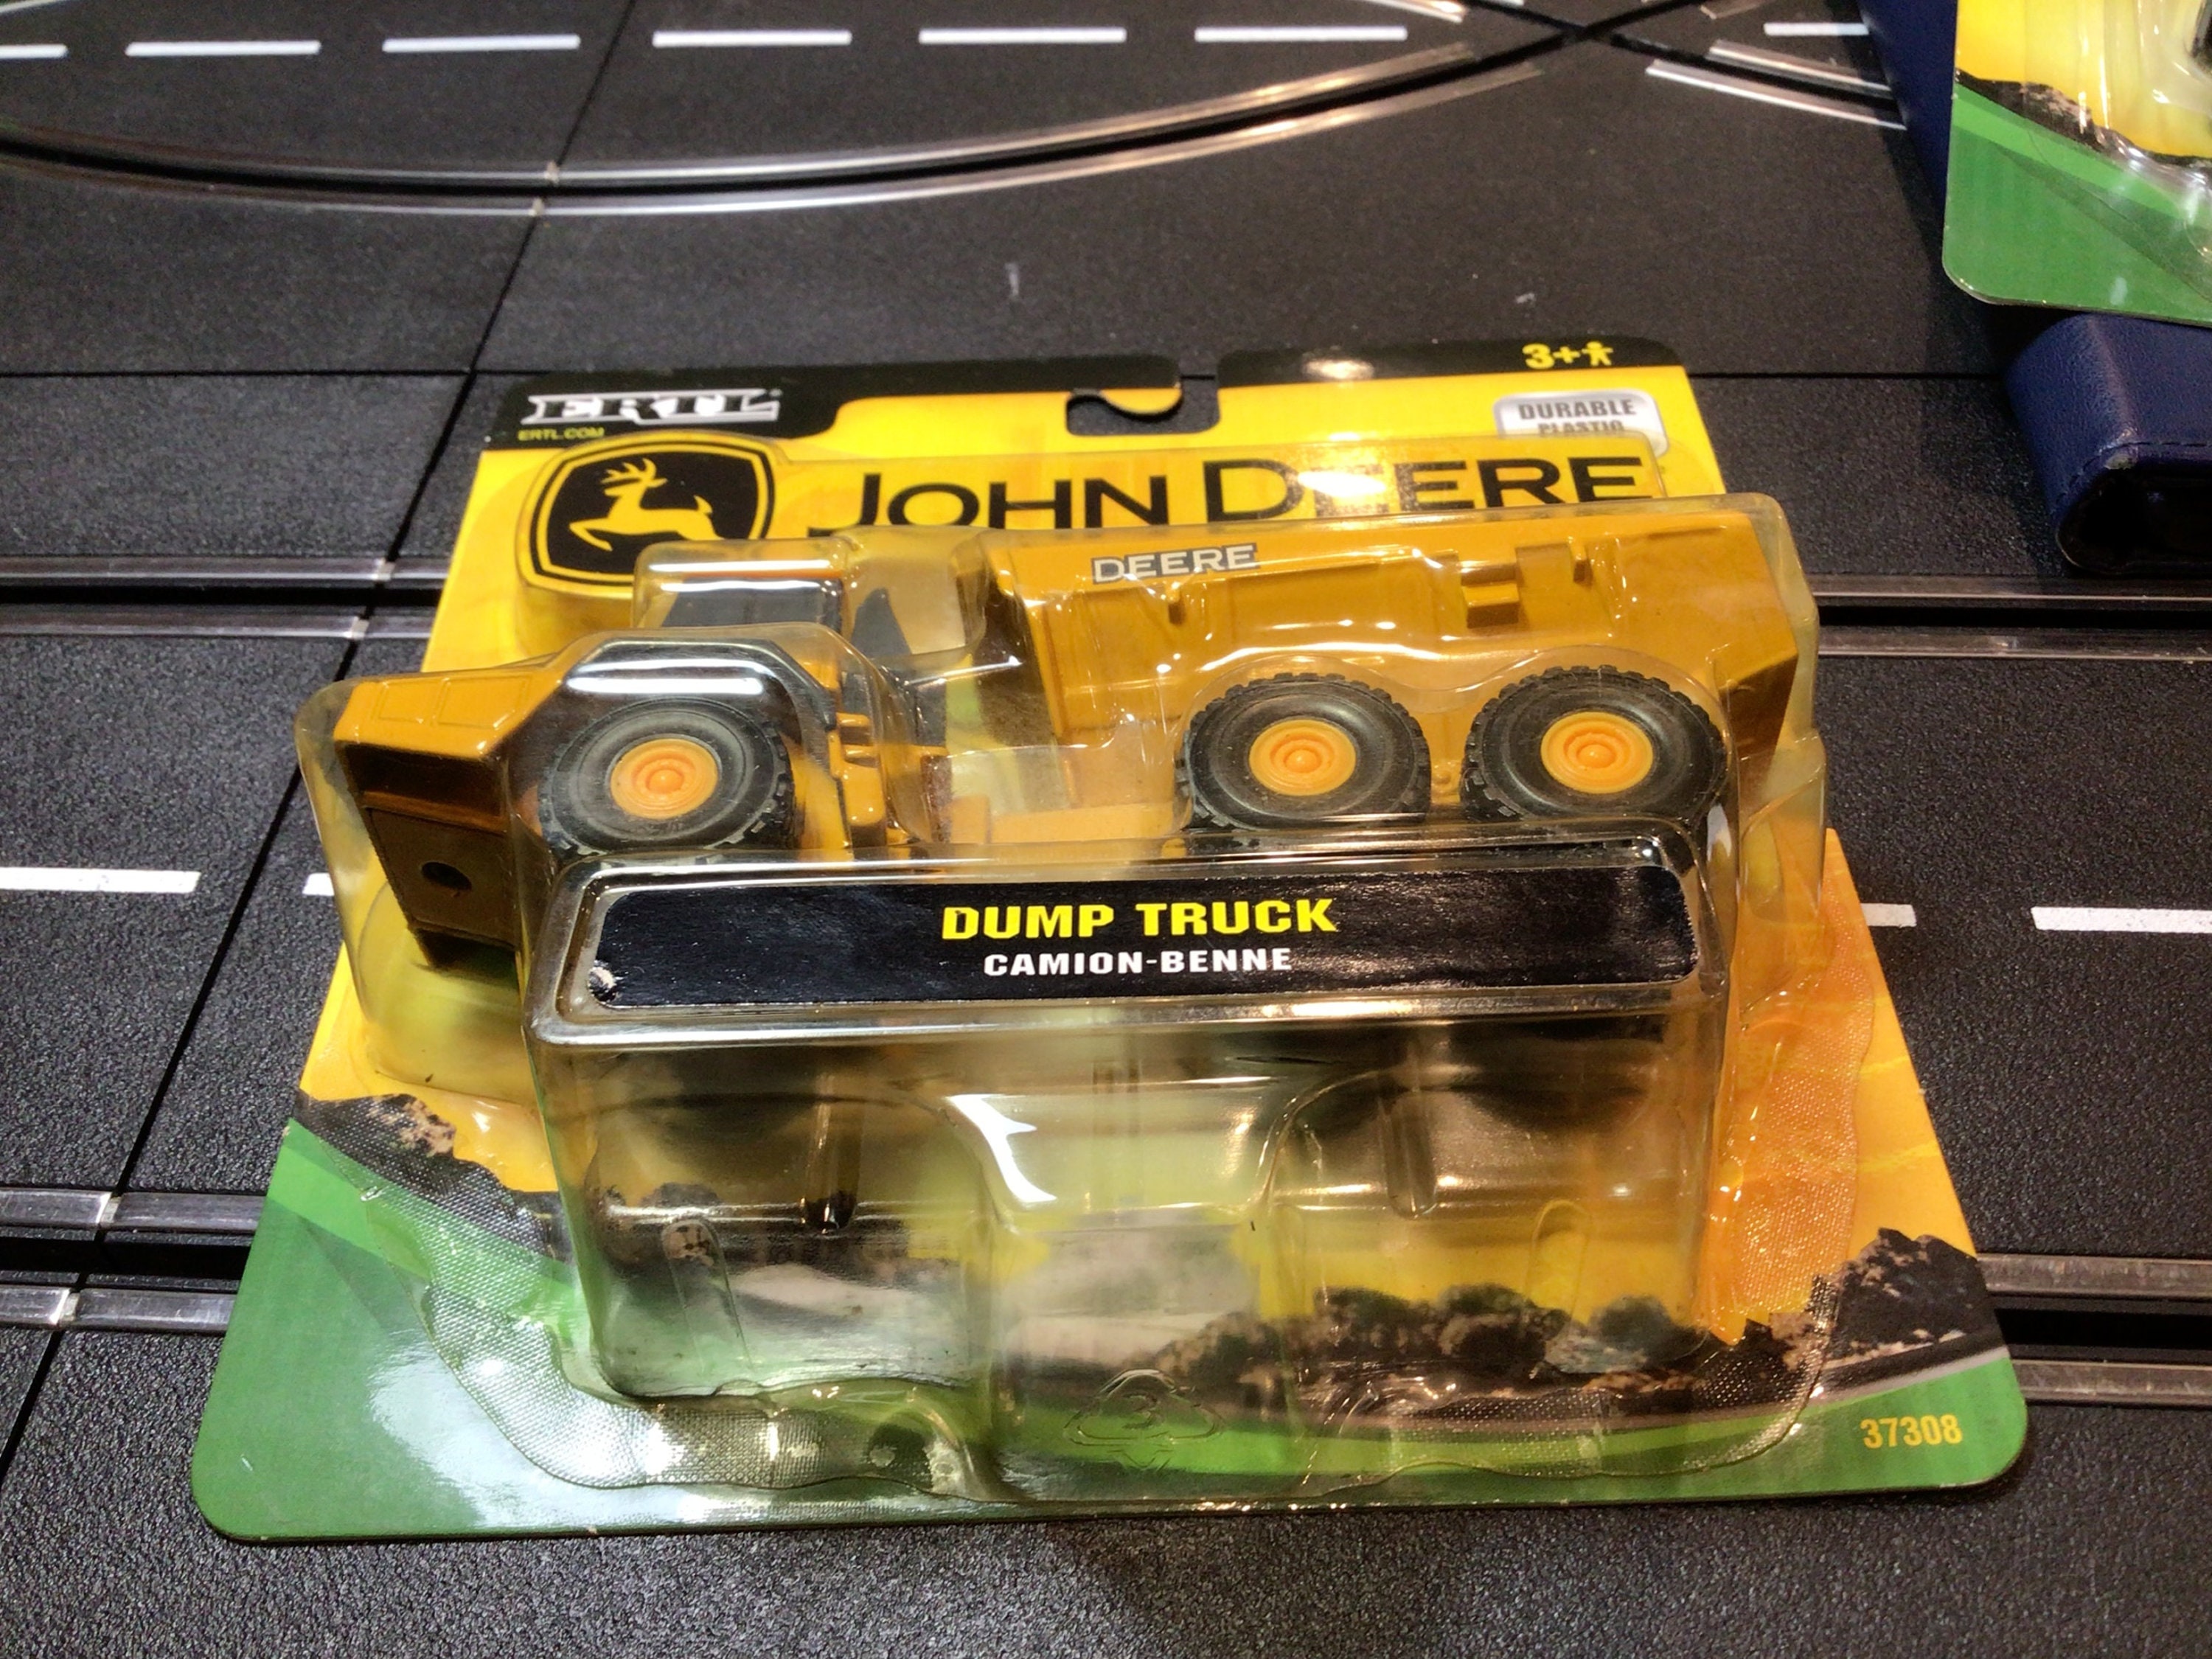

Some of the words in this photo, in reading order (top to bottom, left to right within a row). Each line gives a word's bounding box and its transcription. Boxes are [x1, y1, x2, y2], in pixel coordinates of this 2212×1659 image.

[520, 388, 780, 425] ERTL
[1517, 398, 1637, 420] DURABLE
[518, 426, 605, 442] ERTL.COM
[807, 472, 1170, 538] JOHN
[1092, 543, 1260, 584] DEERE
[942, 905, 1115, 940] DUMP
[1135, 897, 1337, 936] TRUCK
[983, 947, 1293, 977] CAMION-BENNE
[1860, 1413, 1963, 1449] 37308
